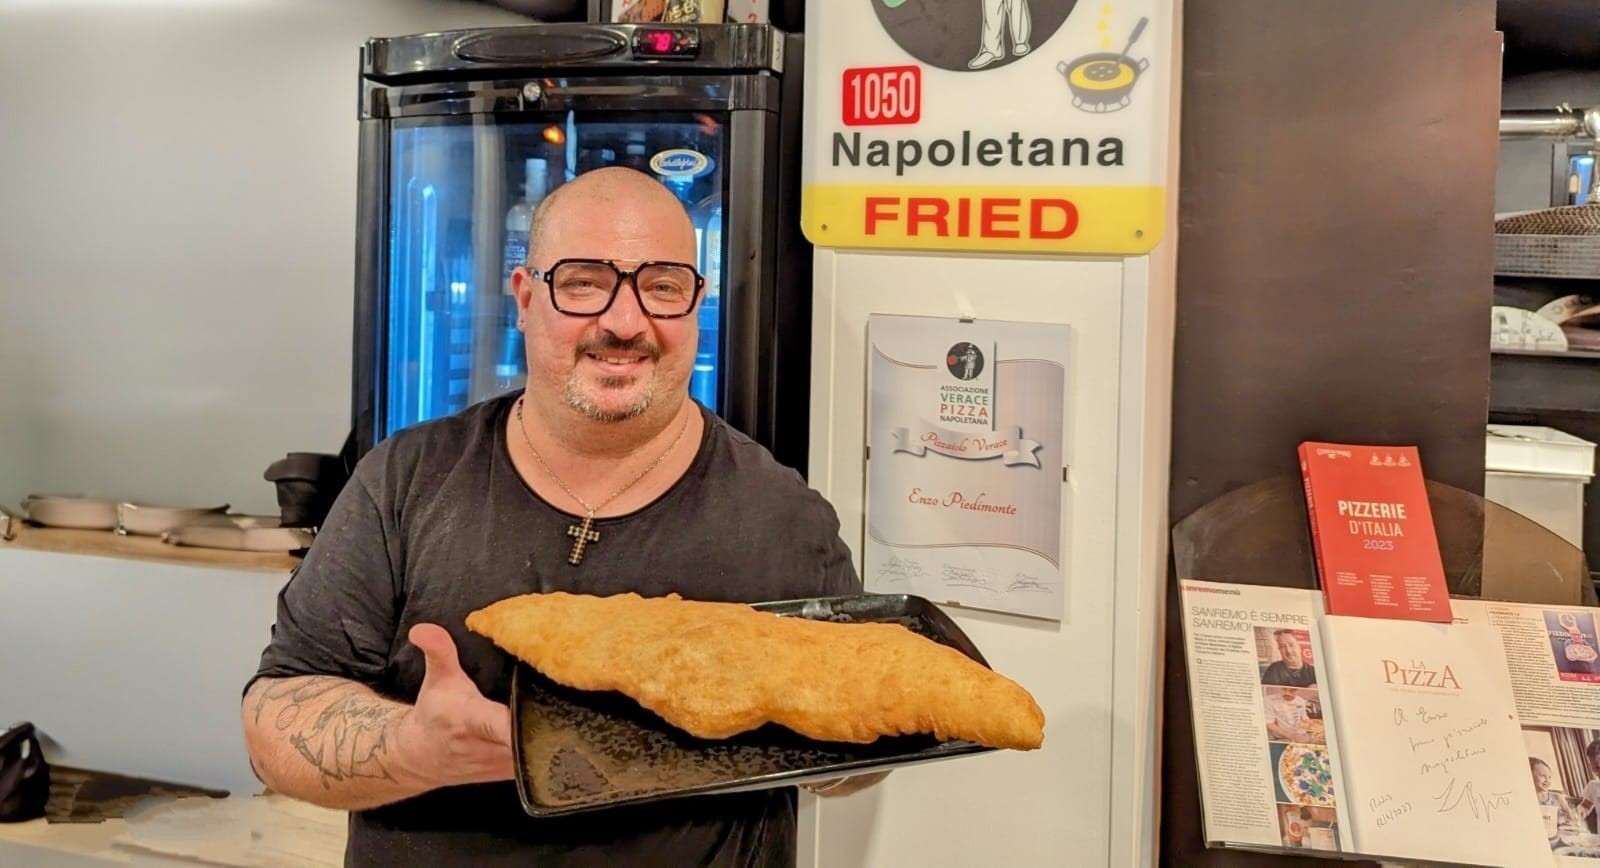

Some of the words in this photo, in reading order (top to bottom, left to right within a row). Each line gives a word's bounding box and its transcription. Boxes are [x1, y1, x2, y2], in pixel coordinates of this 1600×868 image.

[850, 71, 916, 119] 1050
[832, 130, 1124, 176] Napoletana
[864, 196, 1079, 240] FRIED
[940, 385, 989, 394] ASSOCIAZIONE
[940, 393, 989, 406] VERACE
[940, 403, 989, 418] PIZZA
[940, 415, 989, 425] NAPOLETANA
[920, 431, 969, 453] Pizzaiolo
[973, 438, 1009, 452] Verace
[908, 487, 938, 506] Enzo
[942, 491, 1017, 516] Piedimonte
[1337, 499, 1407, 520] PIZZERIE
[1349, 520, 1404, 537] D'ITALIA
[1363, 539, 1395, 551] 2023
[1191, 606, 1249, 621] SANREMO
[1250, 609, 1259, 622] È
[1260, 612, 1310, 626] SEMPRE
[1192, 617, 1252, 632] SANREMO!
[1411, 659, 1427, 669] LA
[1381, 659, 1463, 690] PIZZA
